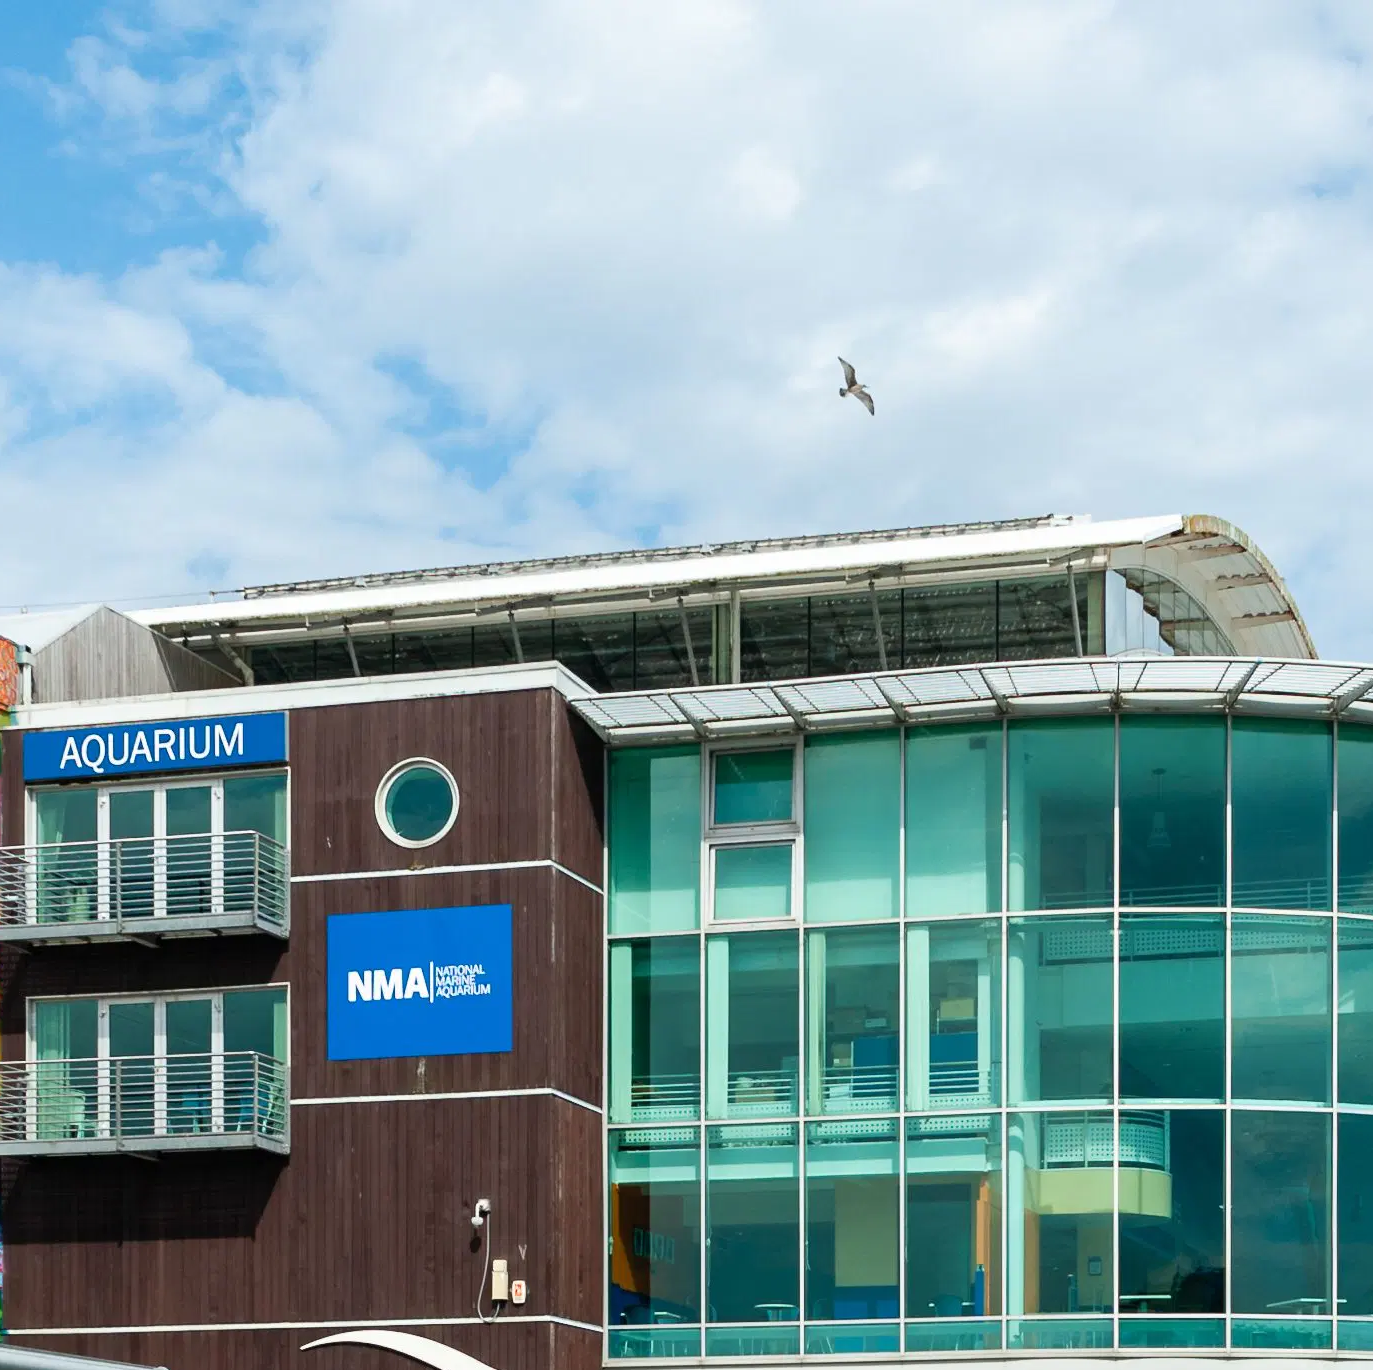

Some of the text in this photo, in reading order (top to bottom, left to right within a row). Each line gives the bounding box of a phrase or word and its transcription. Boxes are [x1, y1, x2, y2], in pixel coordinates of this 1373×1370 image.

[60, 723, 244, 773] AQUARIUM
[435, 964, 486, 976] NATIONAL
[348, 968, 429, 1002] NMA
[436, 975, 476, 986] MARINE
[435, 984, 491, 998] AQUARIUM
